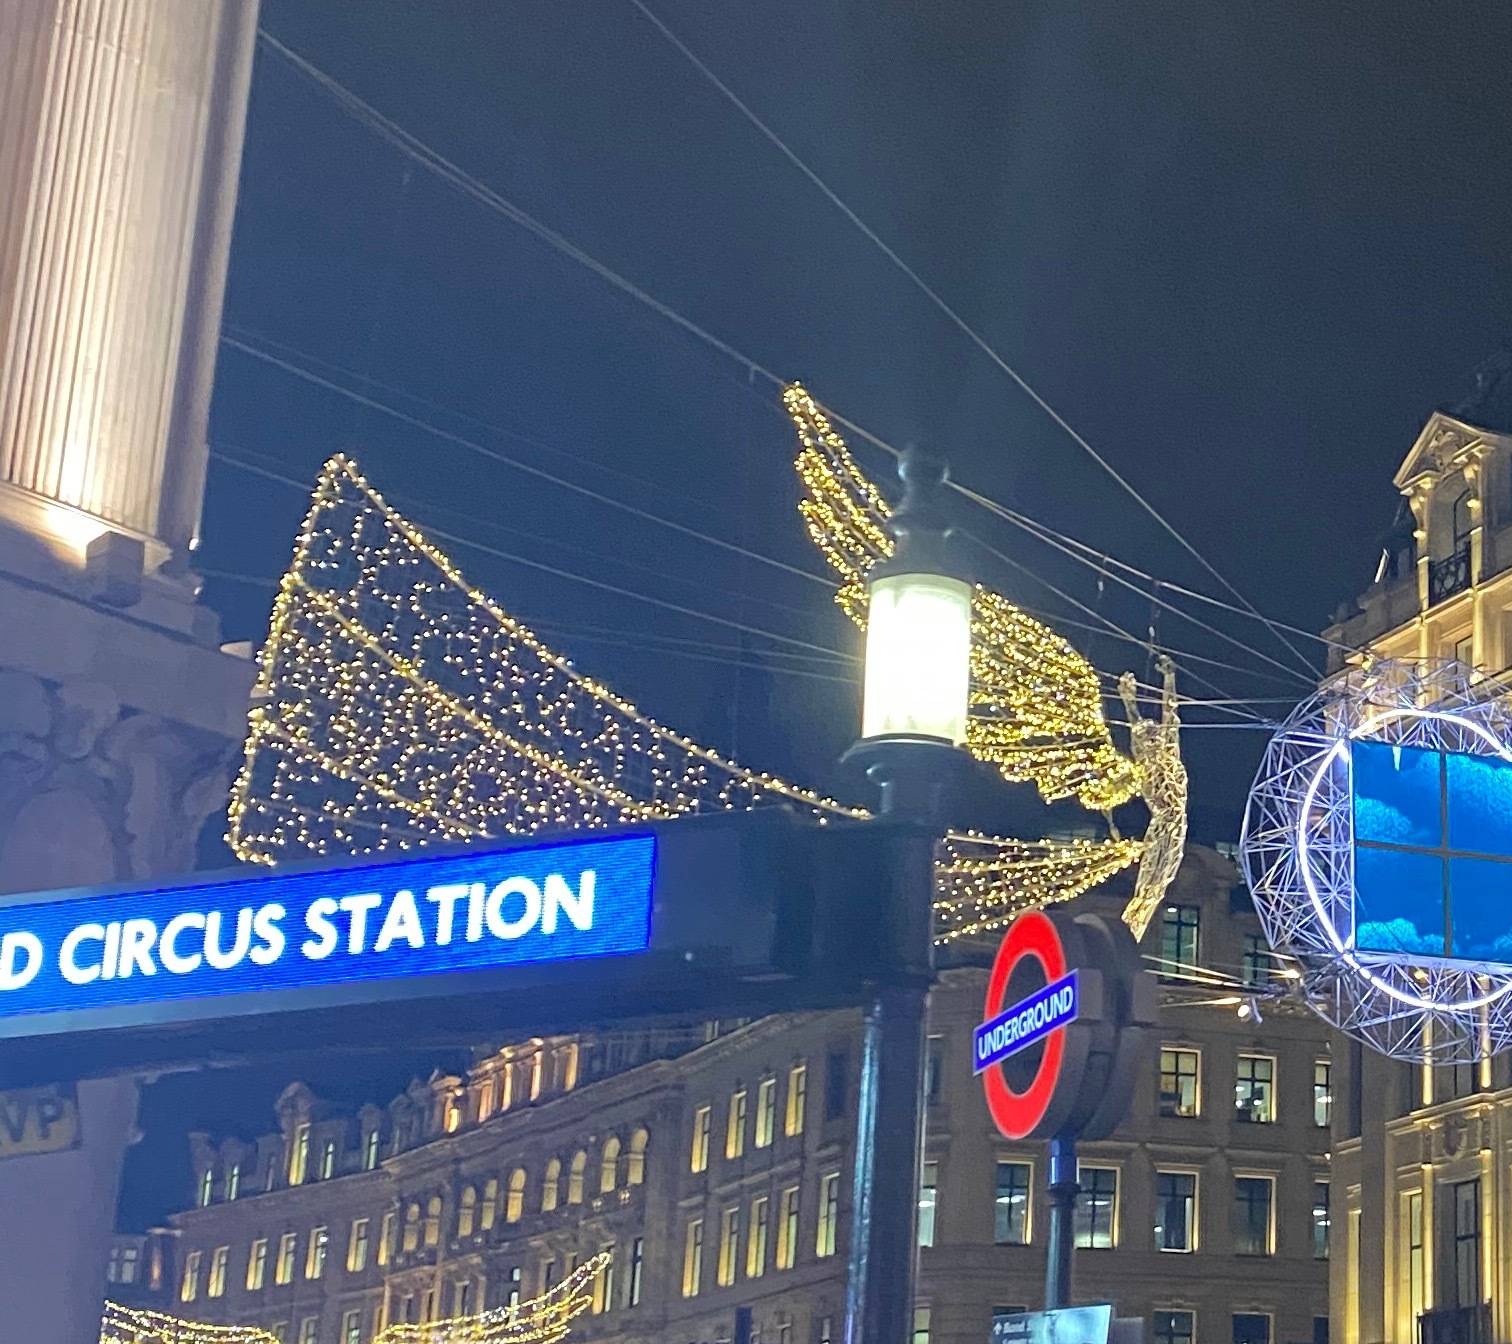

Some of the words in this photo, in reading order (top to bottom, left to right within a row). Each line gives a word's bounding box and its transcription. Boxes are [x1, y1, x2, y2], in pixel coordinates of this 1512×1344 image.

[59, 903, 286, 984] CIRCUS
[302, 870, 596, 959] STATION
[978, 986, 1073, 1060] UNDERGROUND
